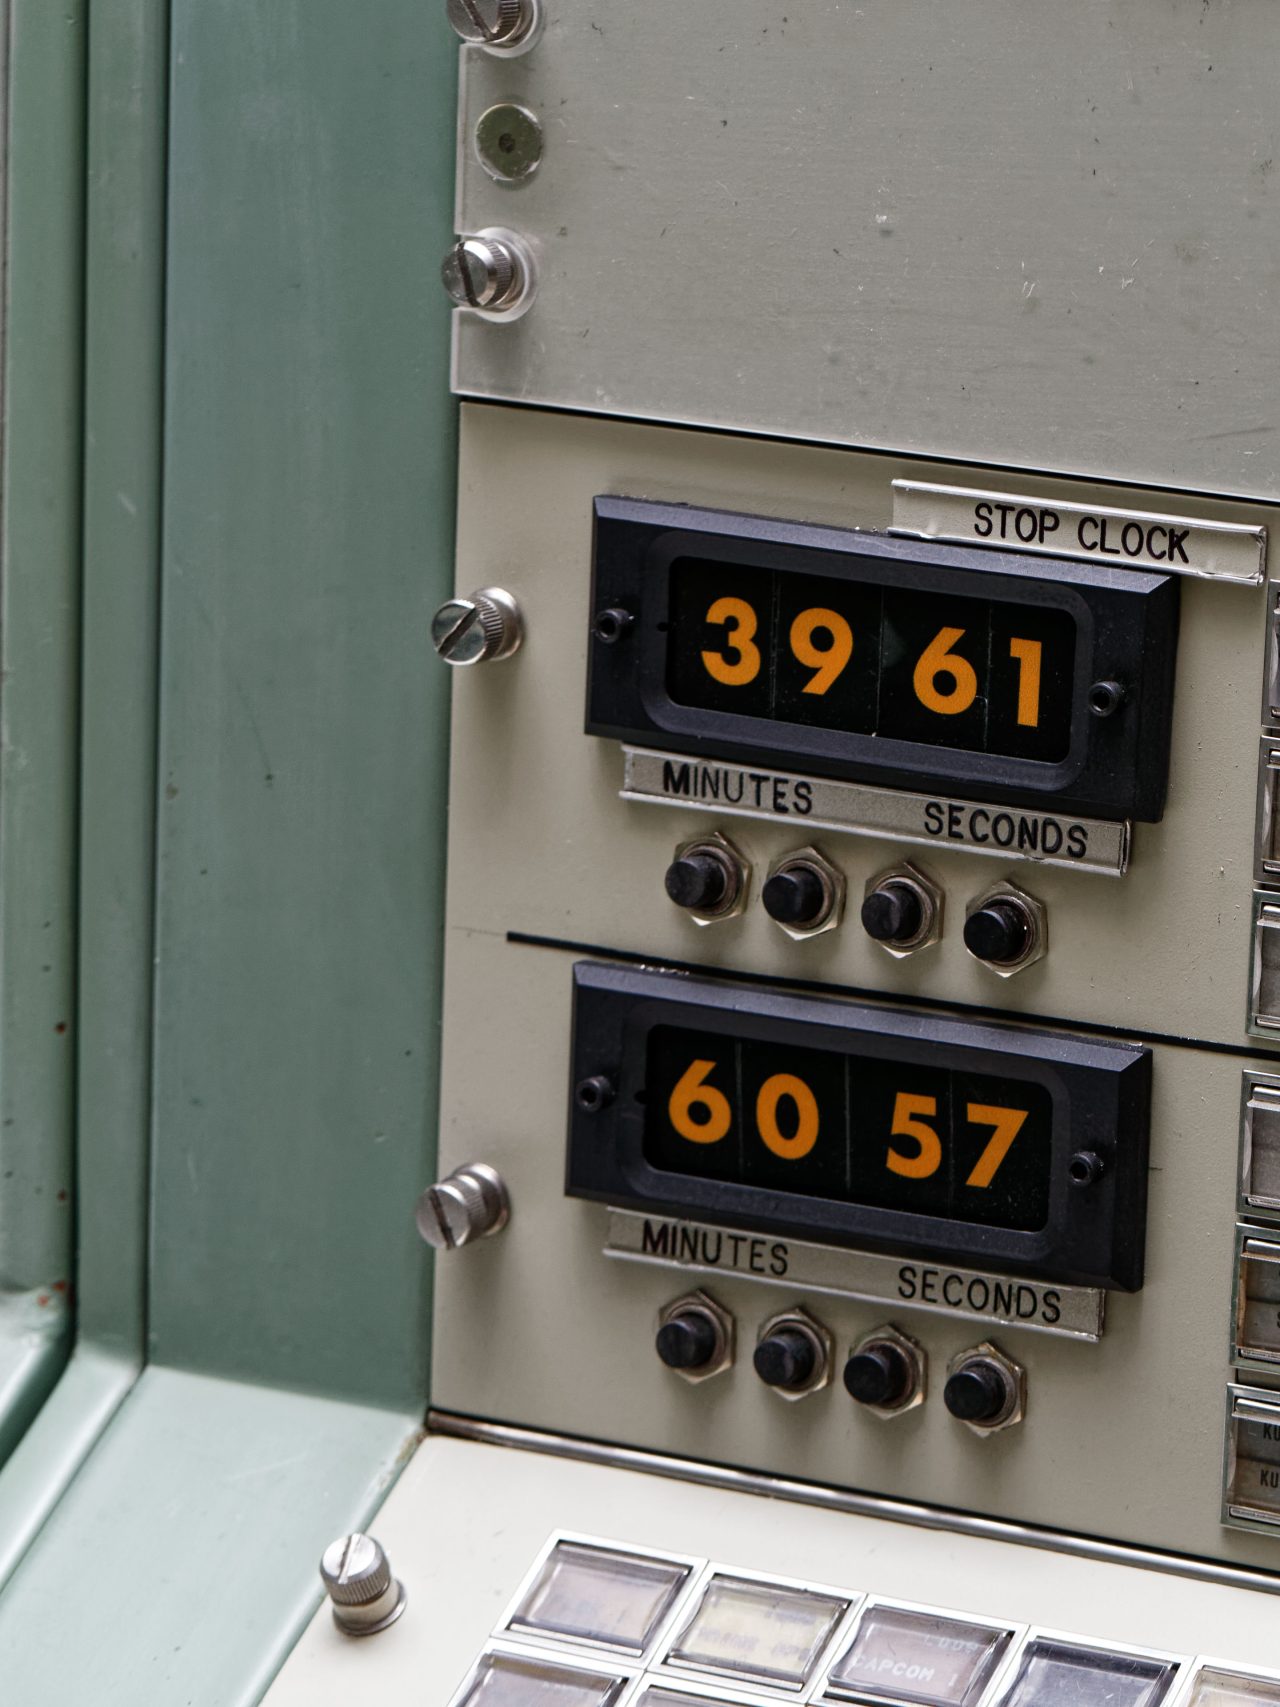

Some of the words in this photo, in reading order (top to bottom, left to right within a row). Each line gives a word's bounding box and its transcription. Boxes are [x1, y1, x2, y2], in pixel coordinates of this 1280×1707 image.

[973, 502, 1060, 544] STOP
[1077, 516, 1190, 563] CLOCK
[662, 759, 812, 815] MINUTES
[923, 800, 1089, 858] SECONDS
[641, 1218, 789, 1276] MINUTES
[897, 1264, 1062, 1323] SECONDS
[853, 1655, 935, 1683] CAPCOM
